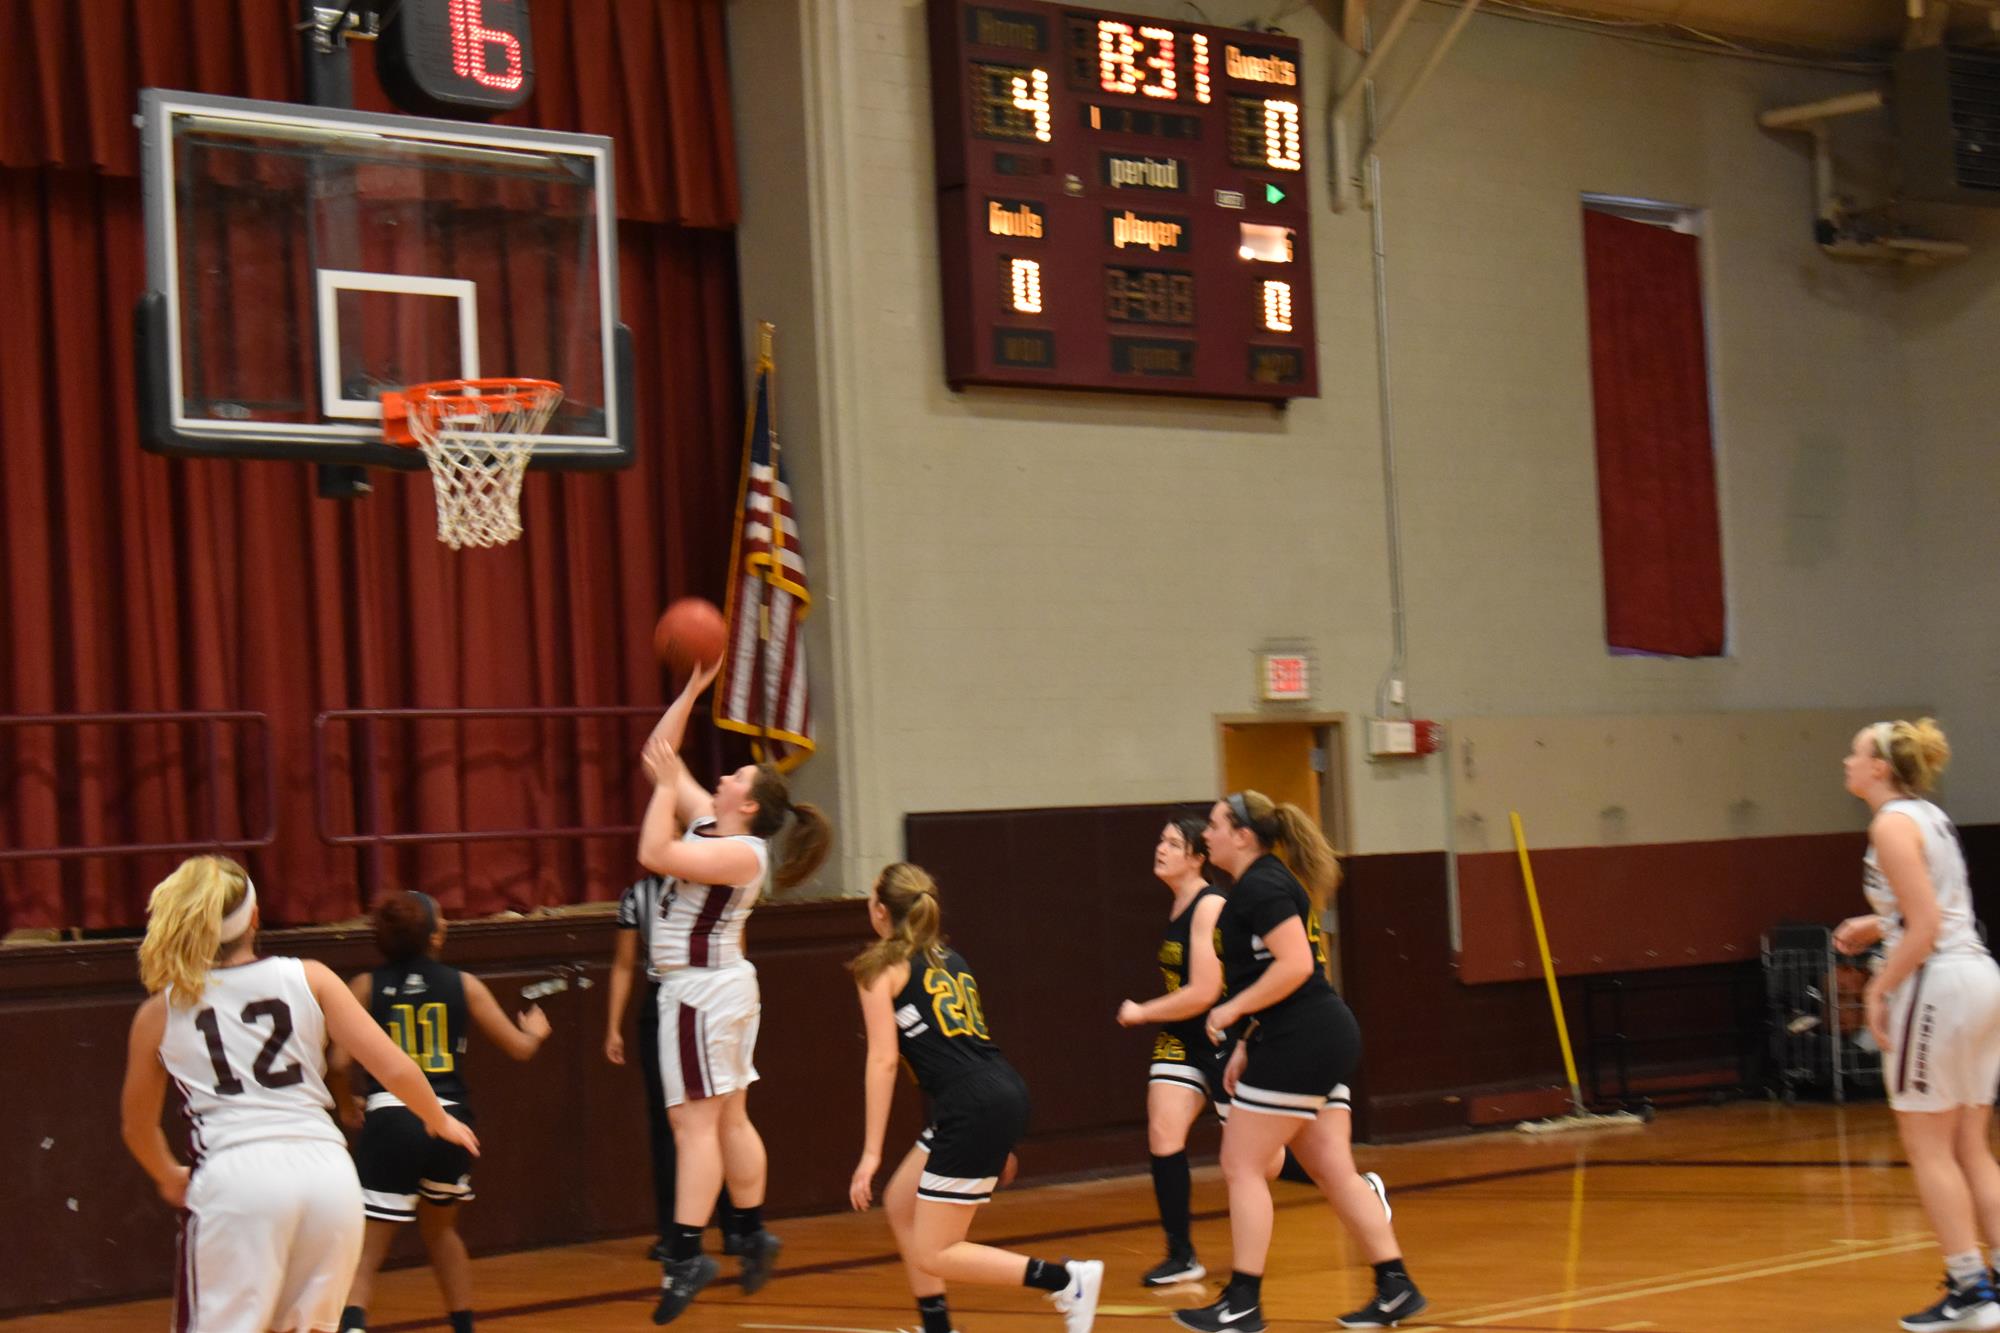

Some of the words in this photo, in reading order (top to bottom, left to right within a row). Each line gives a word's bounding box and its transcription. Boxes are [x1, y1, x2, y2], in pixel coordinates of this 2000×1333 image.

[448, 0, 523, 91] 16
[1225, 44, 1297, 86] Guests
[1012, 69, 1051, 142] 4
[1264, 99, 1301, 170] 0
[1109, 157, 1179, 189] period
[1113, 210, 1182, 252] player
[1011, 258, 1042, 313] 0
[1264, 280, 1292, 332] 0
[195, 998, 304, 1095] 12
[386, 1002, 455, 1073] 11
